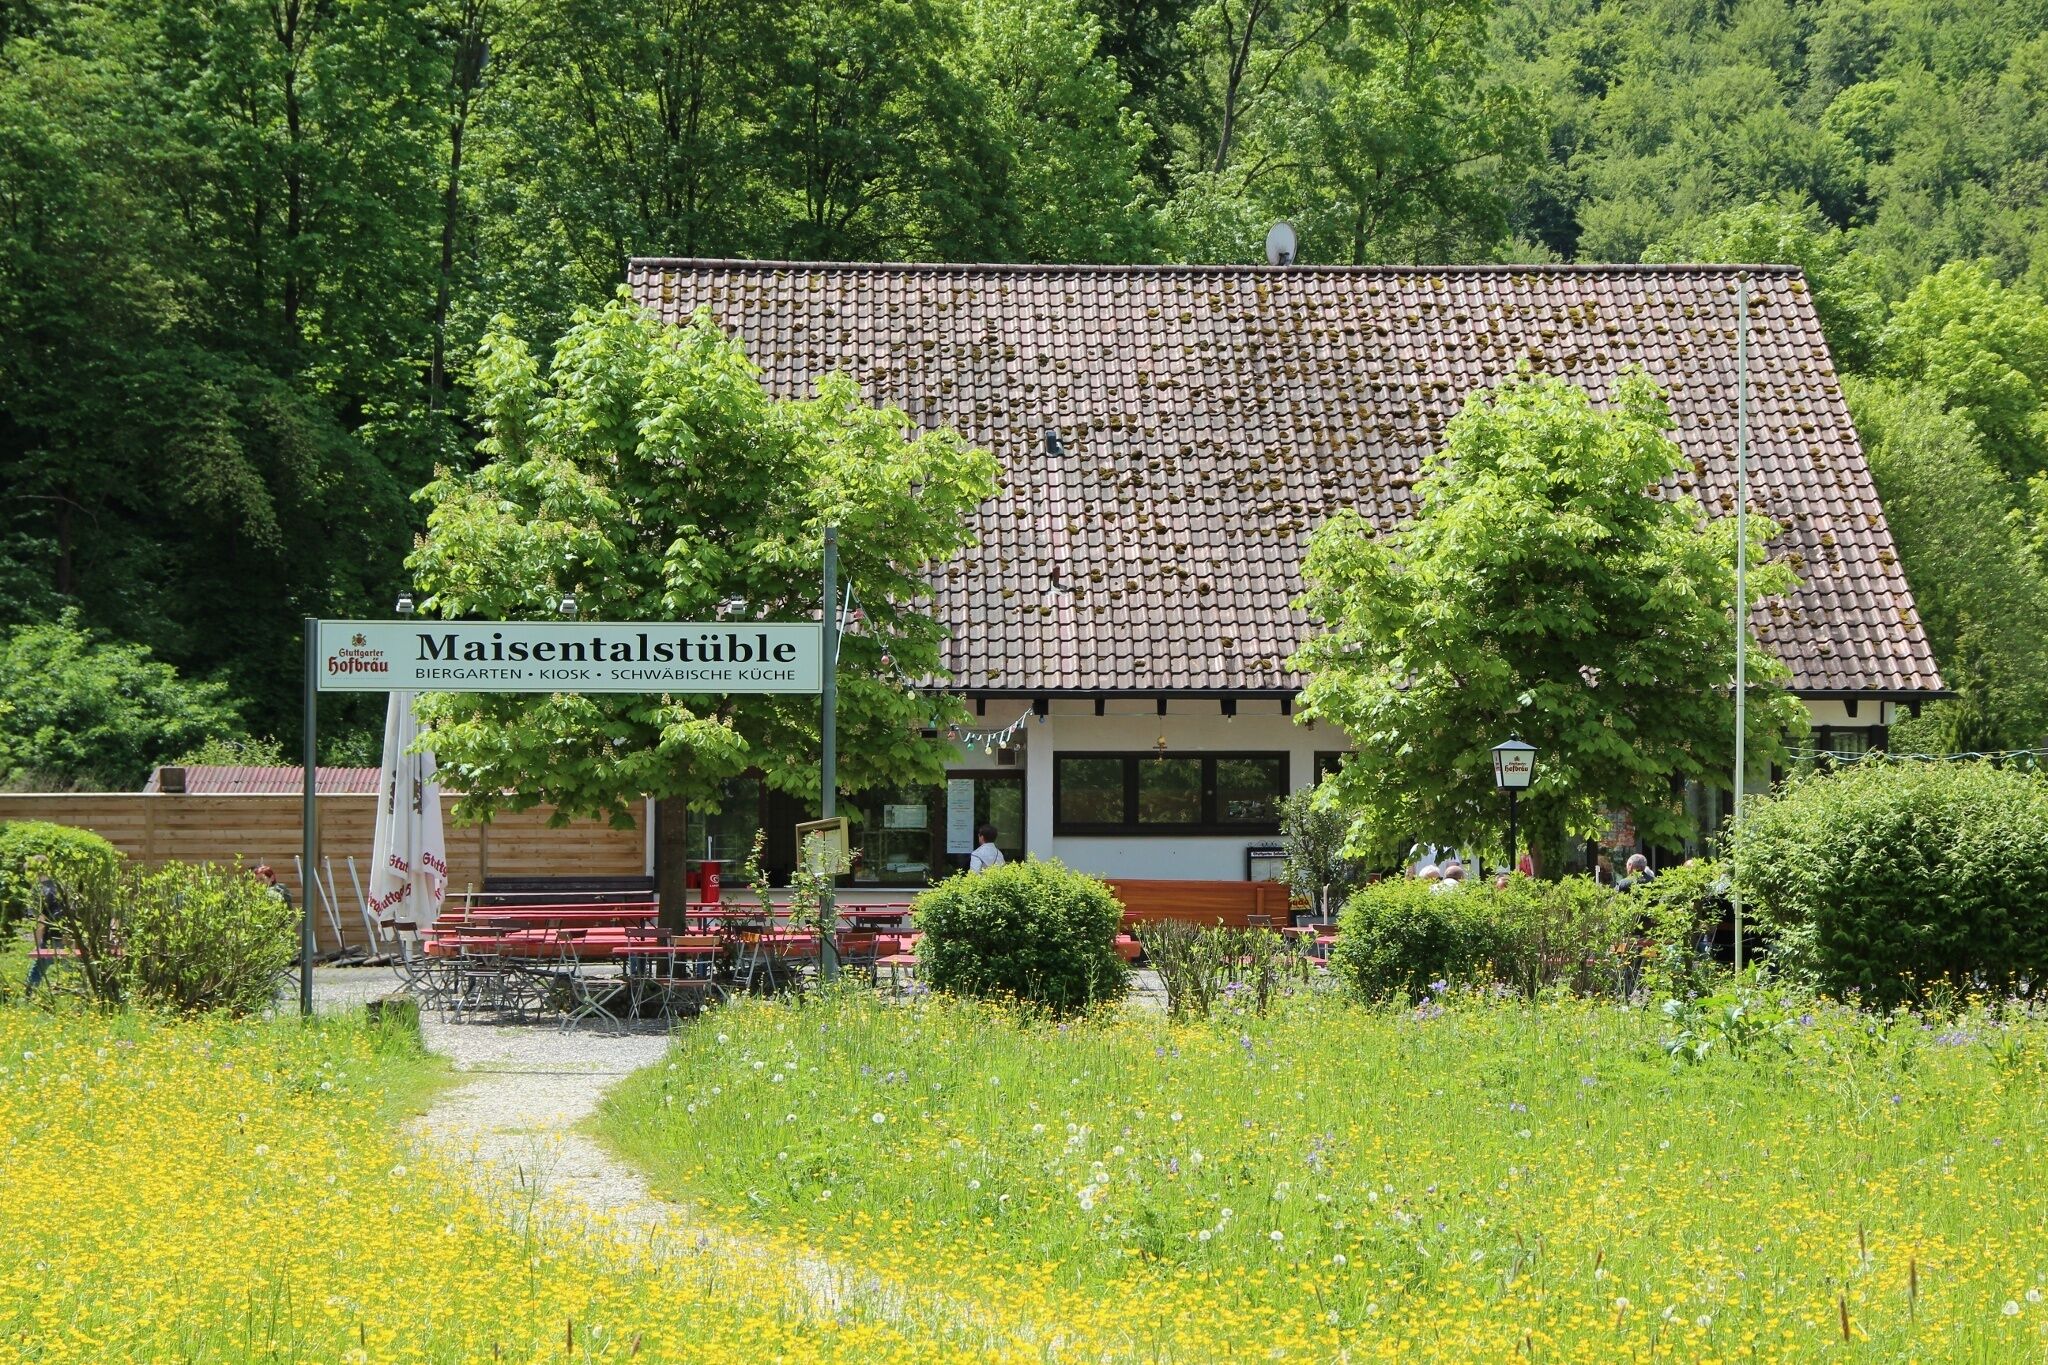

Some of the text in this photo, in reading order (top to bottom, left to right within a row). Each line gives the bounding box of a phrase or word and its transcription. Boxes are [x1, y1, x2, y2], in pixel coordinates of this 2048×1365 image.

[338, 648, 384, 658] Stuttgarter
[416, 633, 796, 662] Maisentalstüble
[328, 656, 389, 675] Hofbräu
[415, 668, 796, 681] BIERGARTEN KIOSK SCHWÄBISCHE KÜCHE
